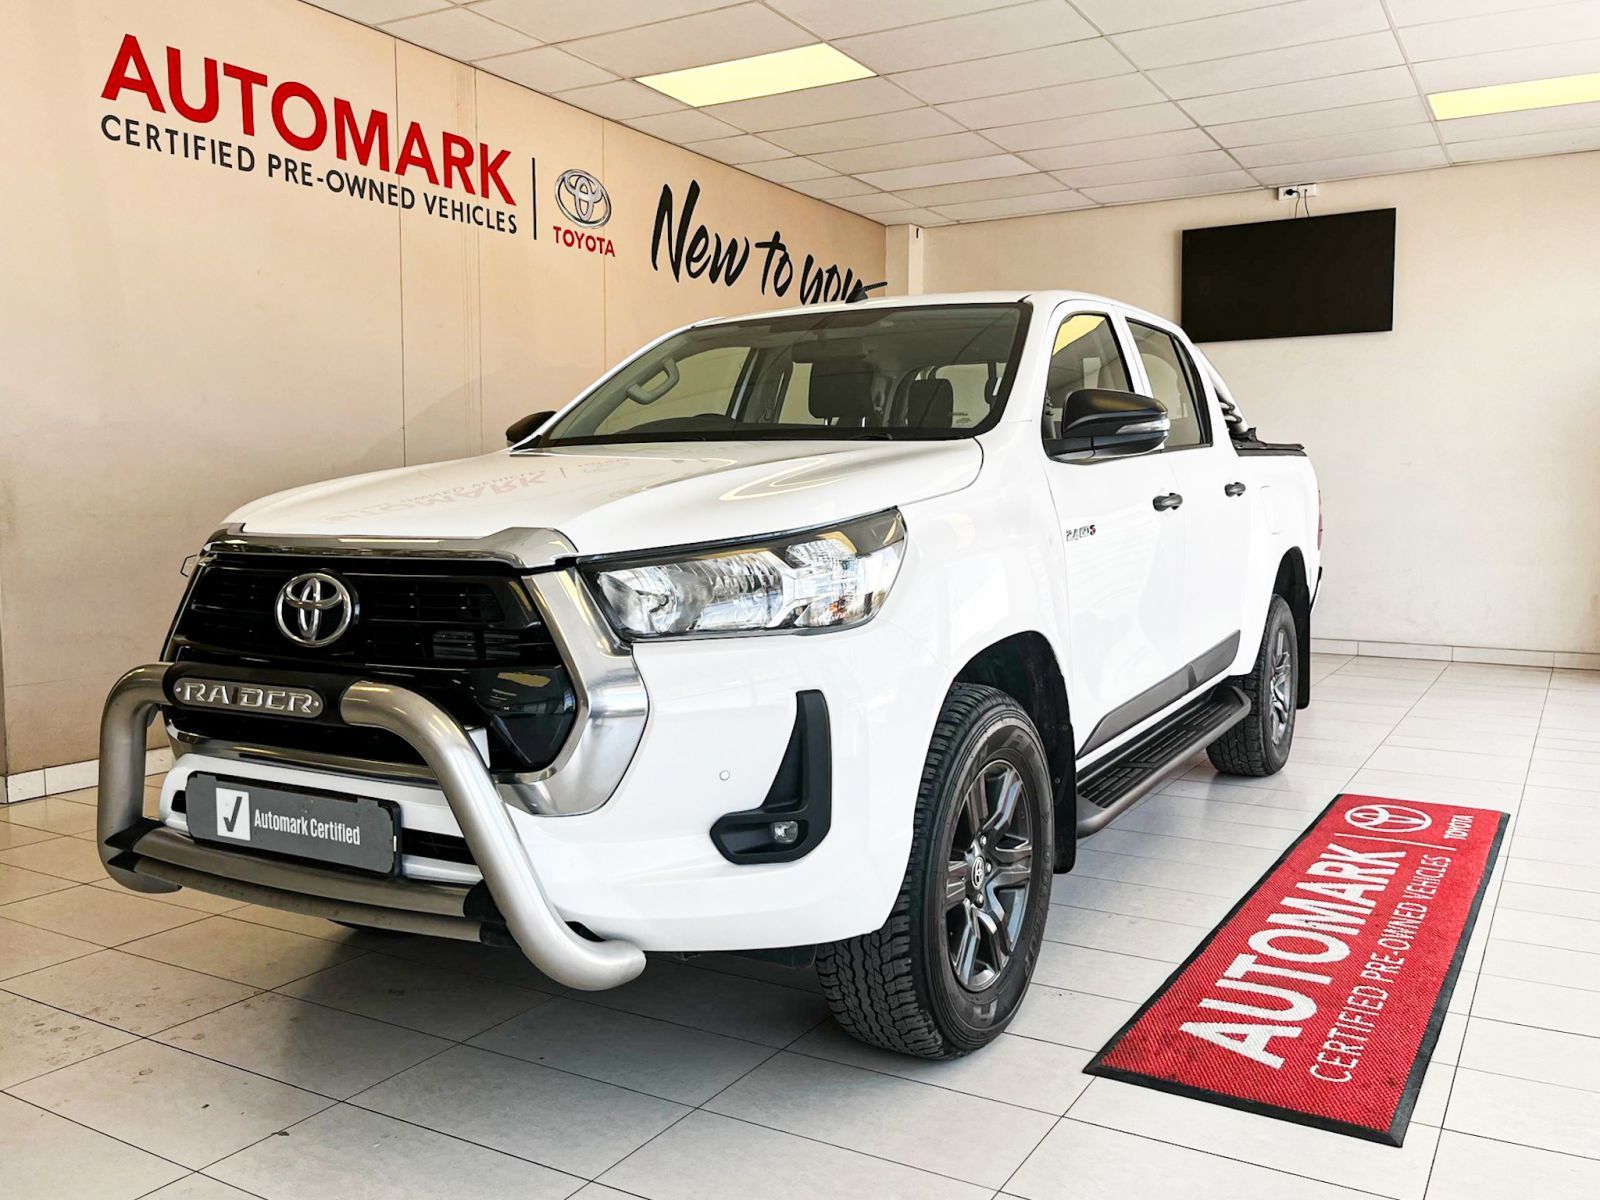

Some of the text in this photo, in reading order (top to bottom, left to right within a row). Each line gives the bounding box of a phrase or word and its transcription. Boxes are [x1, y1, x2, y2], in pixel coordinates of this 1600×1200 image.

[101, 34, 517, 206] AUTOMARK
[101, 114, 518, 235] CERTIFIED PRE-OWNED VEHICLES
[553, 225, 616, 258] TOYOTA
[651, 179, 750, 287] New
[755, 230, 794, 298] to
[183, 682, 312, 714] RAIDER
[254, 808, 361, 846] Automark Certified
[1442, 814, 1475, 841] TOYOTA
[1178, 842, 1407, 1070] AUTOMARK
[1309, 853, 1452, 1083] CERTIFIED PRE-OWNED VEHICLES
